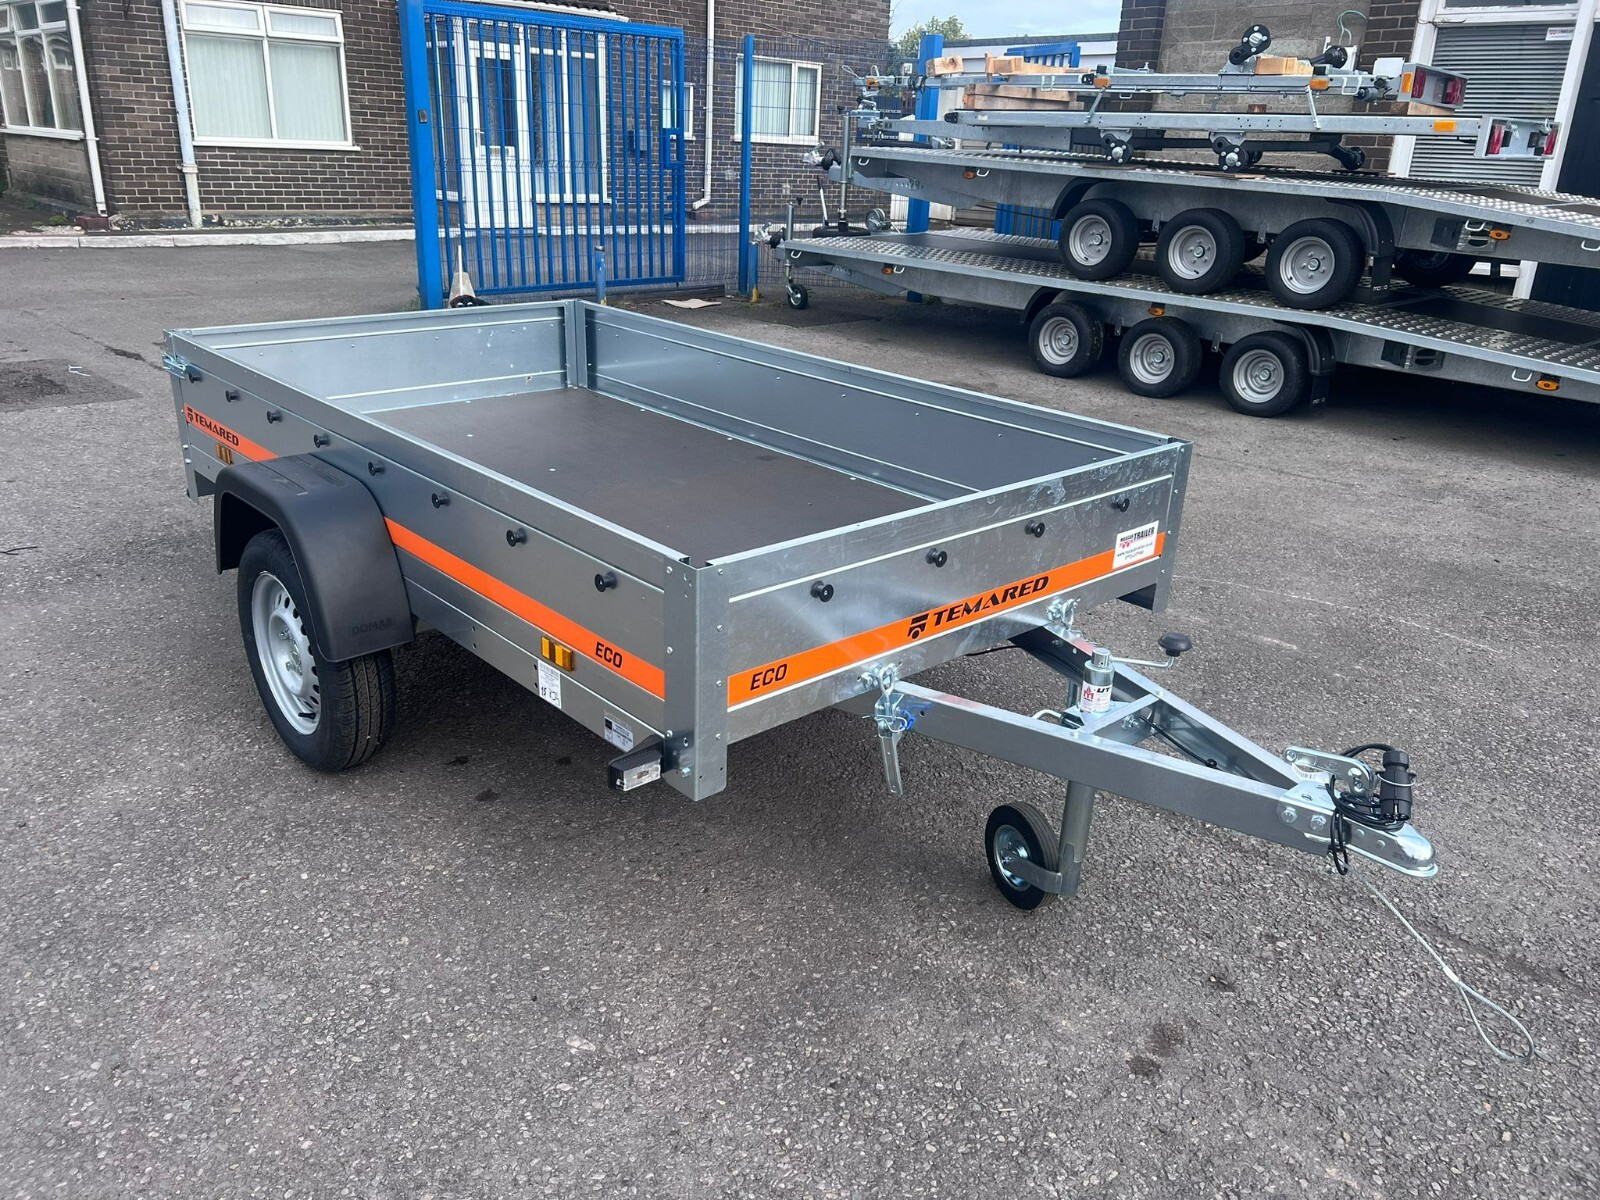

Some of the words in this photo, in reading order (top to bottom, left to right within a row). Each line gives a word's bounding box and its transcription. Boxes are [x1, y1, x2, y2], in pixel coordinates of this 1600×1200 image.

[194, 411, 239, 447] TEMARED
[1133, 526, 1155, 541] TRAILER
[933, 575, 1050, 628] TEMARED
[595, 641, 623, 669] ECO
[750, 664, 788, 691] ECO
